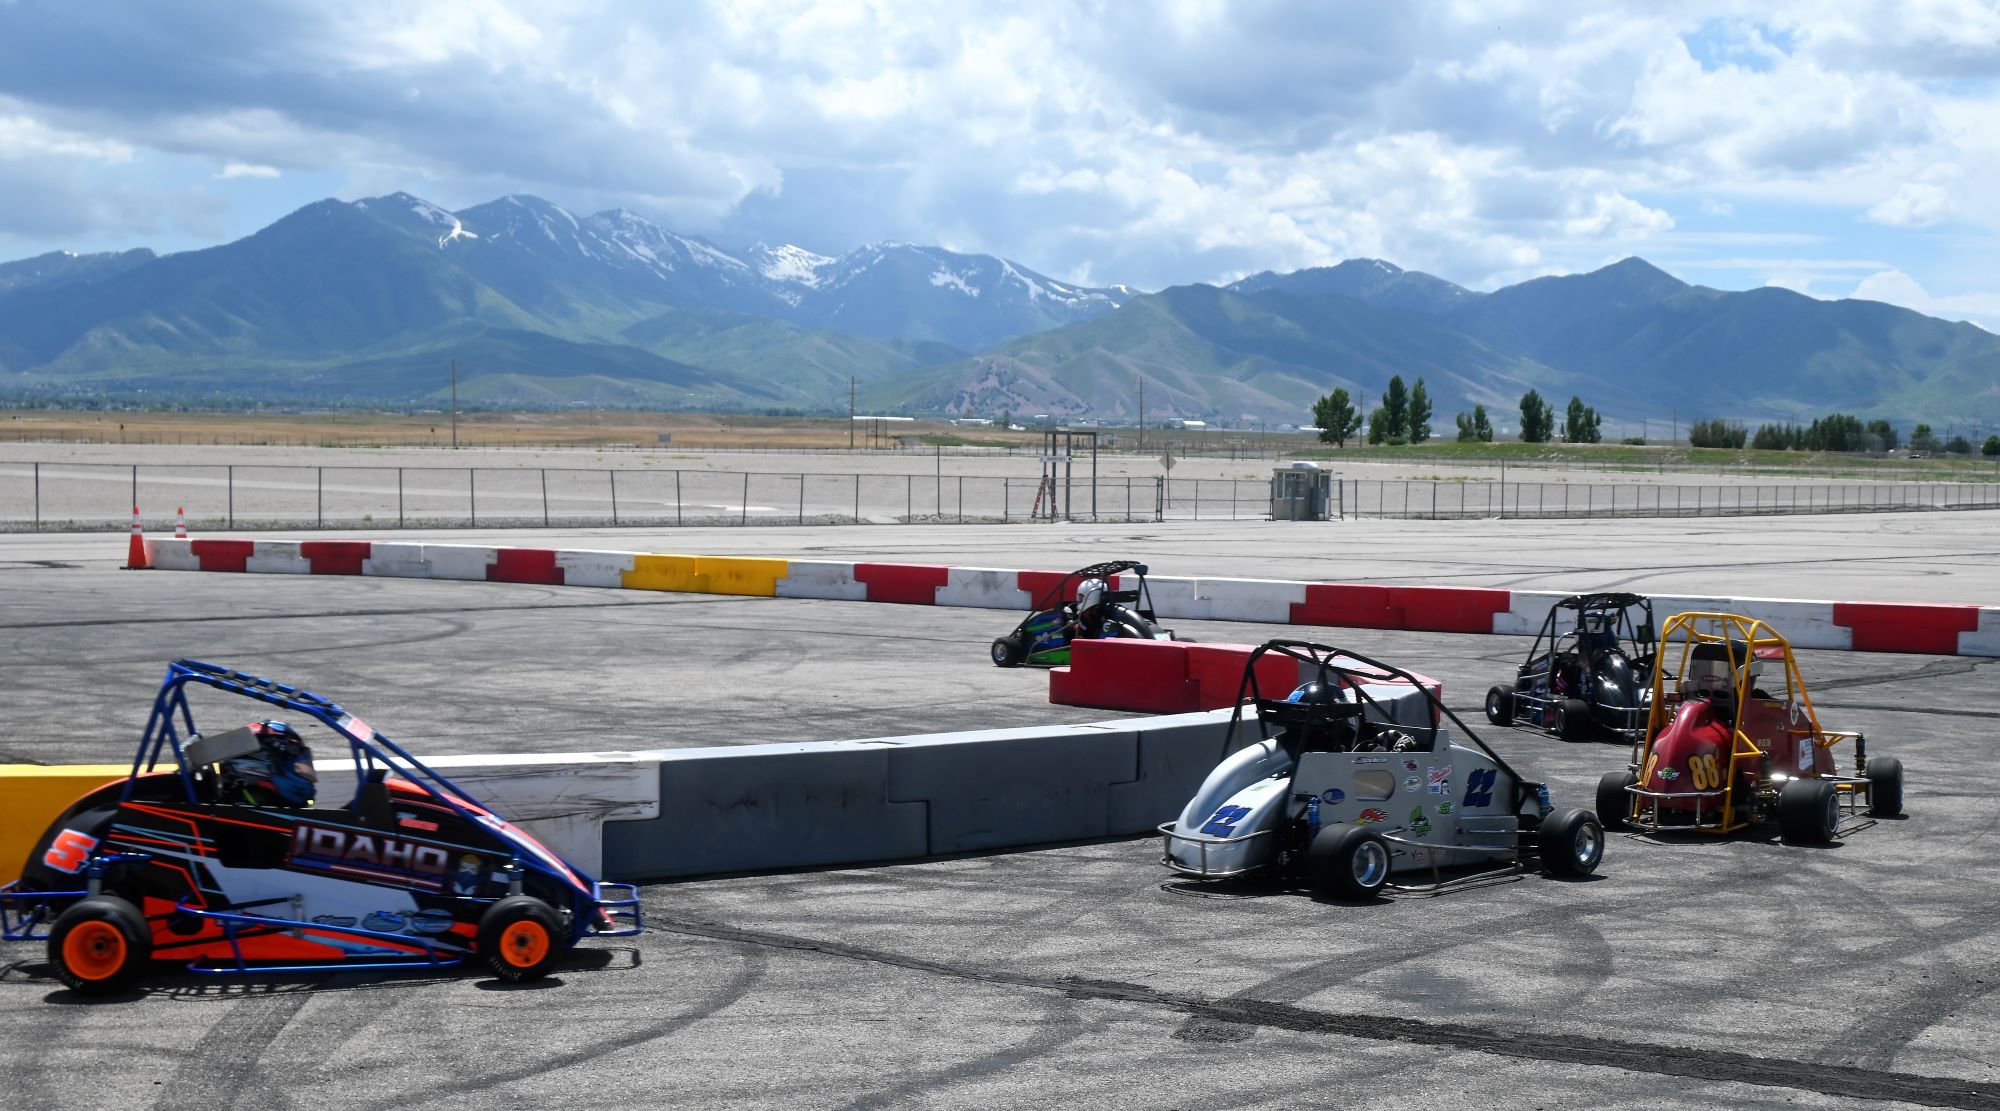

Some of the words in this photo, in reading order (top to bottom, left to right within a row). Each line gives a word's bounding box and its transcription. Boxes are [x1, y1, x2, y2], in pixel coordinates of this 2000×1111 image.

[1462, 768, 1498, 807] 22
[1689, 754, 1720, 790] 88
[1201, 804, 1252, 838] 22
[296, 826, 449, 875] IDAHO
